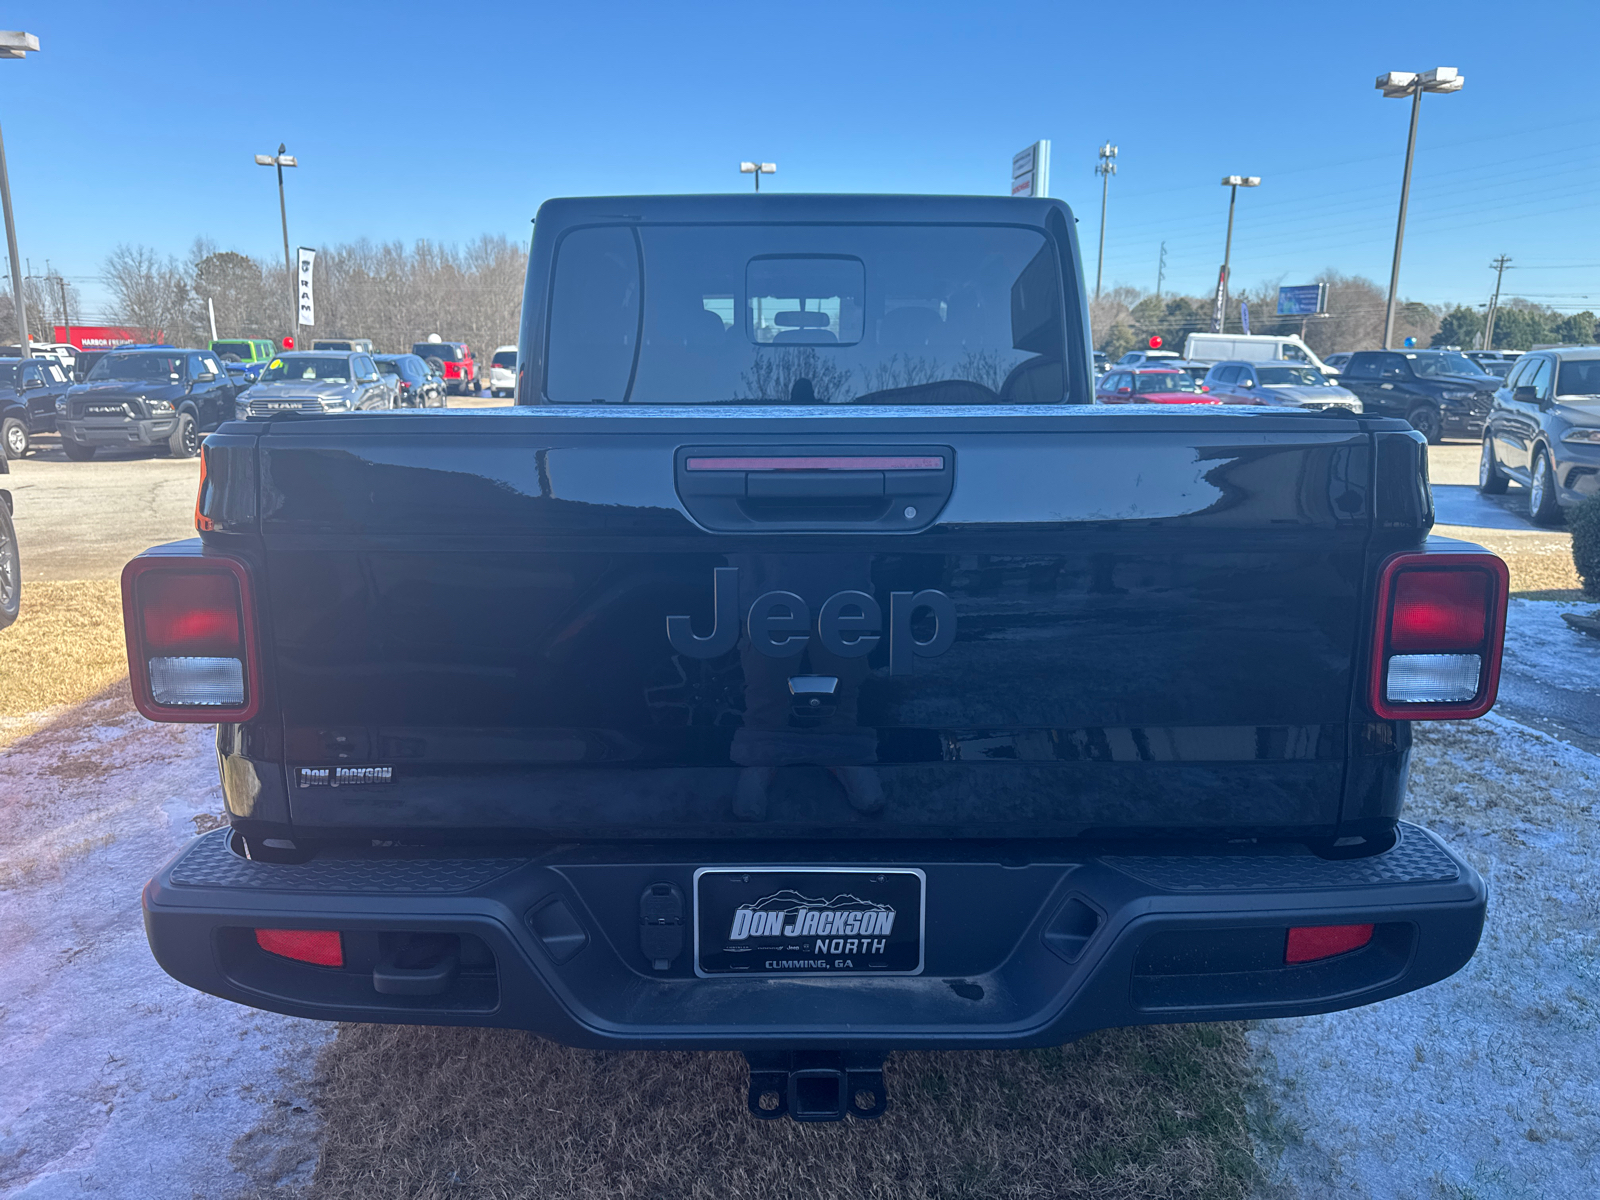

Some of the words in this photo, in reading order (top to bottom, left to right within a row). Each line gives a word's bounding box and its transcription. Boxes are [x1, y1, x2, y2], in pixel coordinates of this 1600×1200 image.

[301, 280, 311, 311] RAM
[81, 338, 107, 346] HARBOR
[666, 567, 957, 676] Jeep
[300, 768, 329, 788] DON
[330, 767, 392, 787] JACKSON
[729, 909, 785, 940] DON
[784, 908, 896, 937] JACKSON
[814, 939, 886, 954] NORTH
[765, 960, 830, 969] CUMMING,
[834, 960, 853, 968] GA
